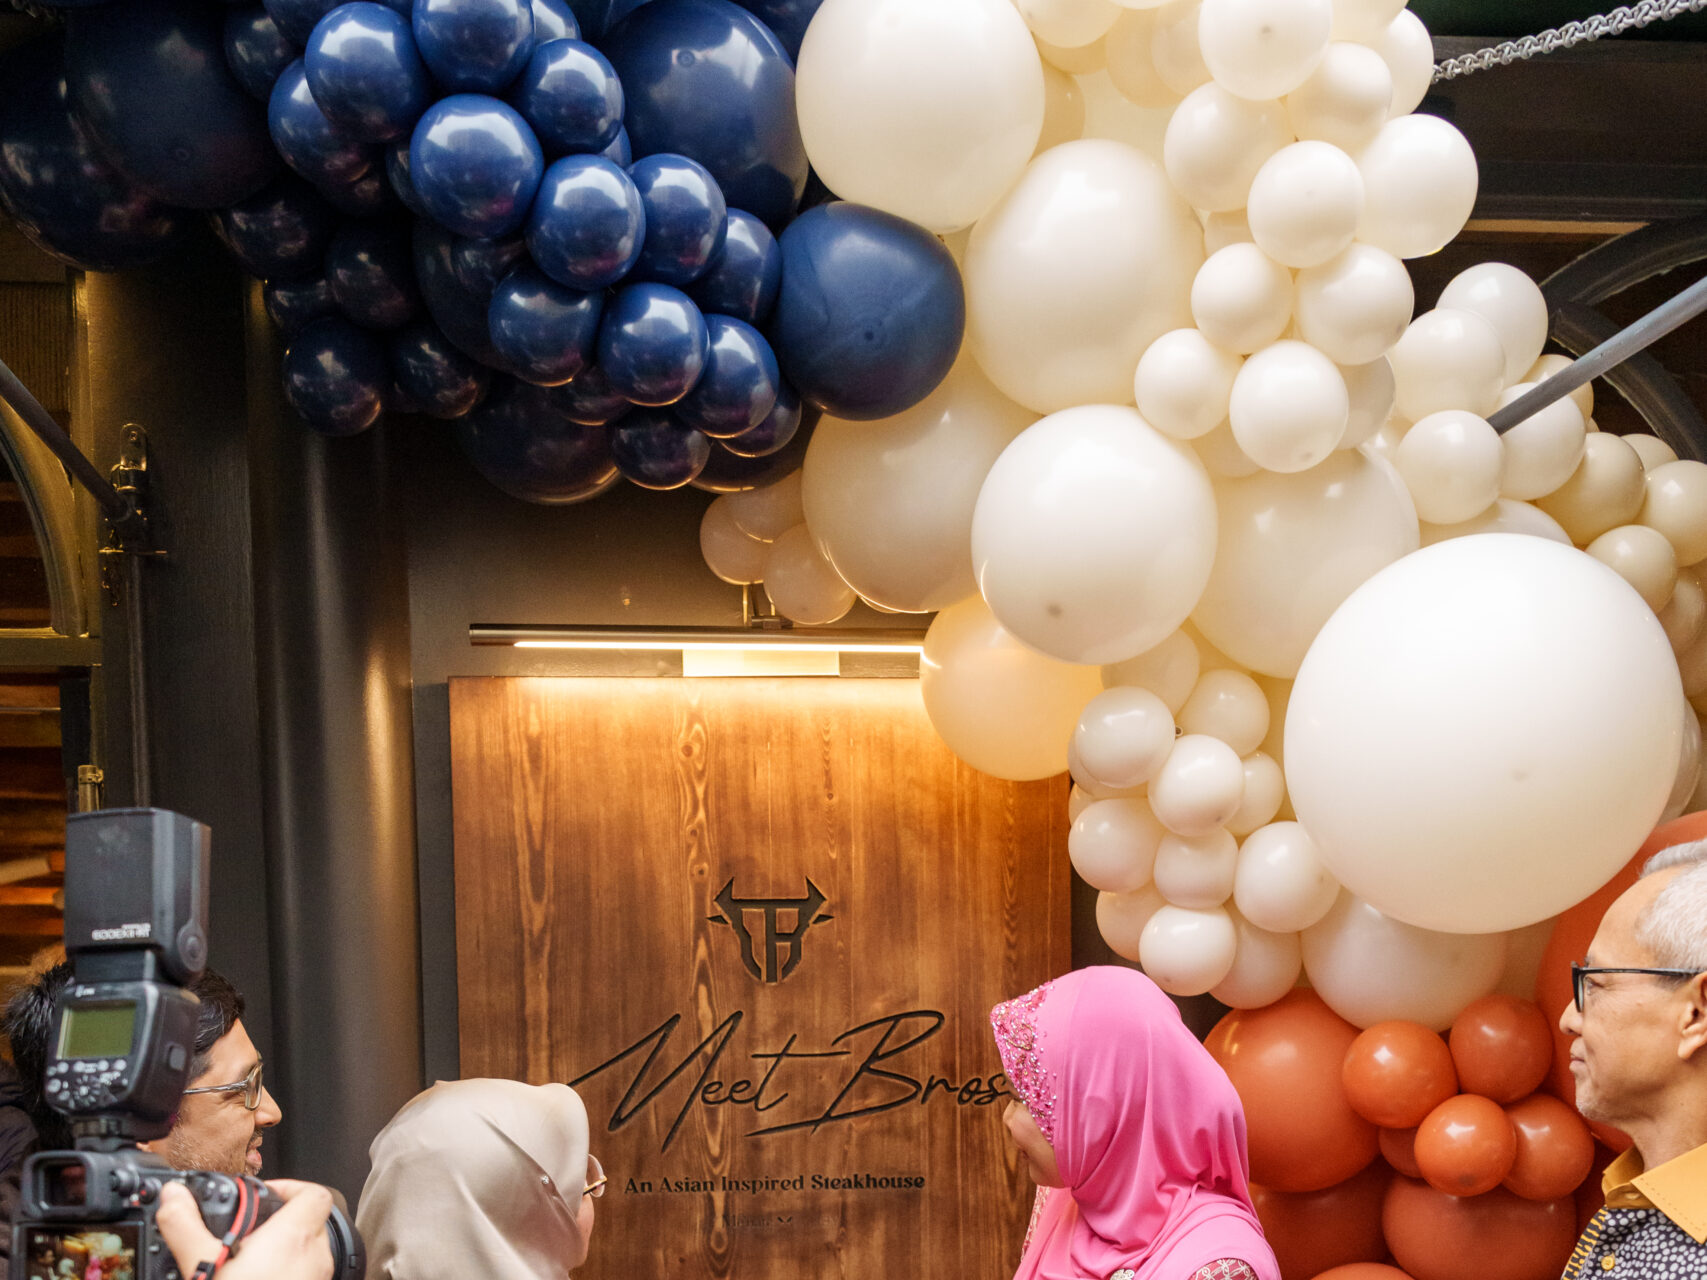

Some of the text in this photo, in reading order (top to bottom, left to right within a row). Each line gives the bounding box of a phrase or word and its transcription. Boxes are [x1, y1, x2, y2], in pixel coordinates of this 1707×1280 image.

[568, 1010, 1010, 1153] Meet Bros
[625, 1173, 925, 1195] An Asian Inspired Steakhouse
